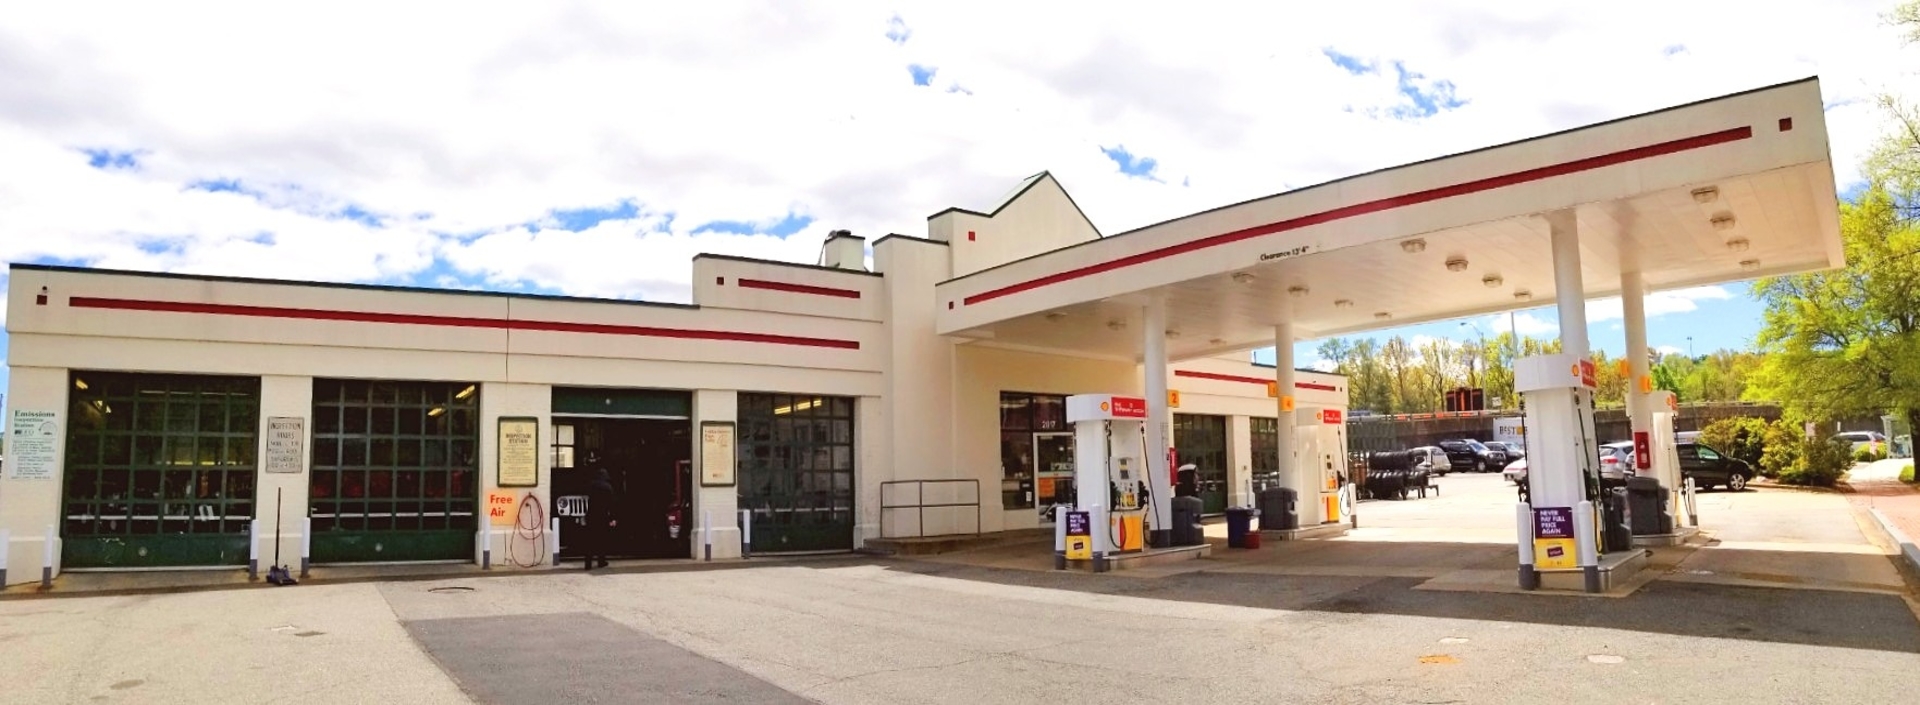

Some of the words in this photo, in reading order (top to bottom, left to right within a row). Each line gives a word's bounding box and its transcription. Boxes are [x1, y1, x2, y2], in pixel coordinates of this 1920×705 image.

[1260, 251, 1291, 261] Clearance
[1171, 393, 1177, 403] 2
[490, 494, 512, 504] Free
[490, 507, 505, 517] Air
